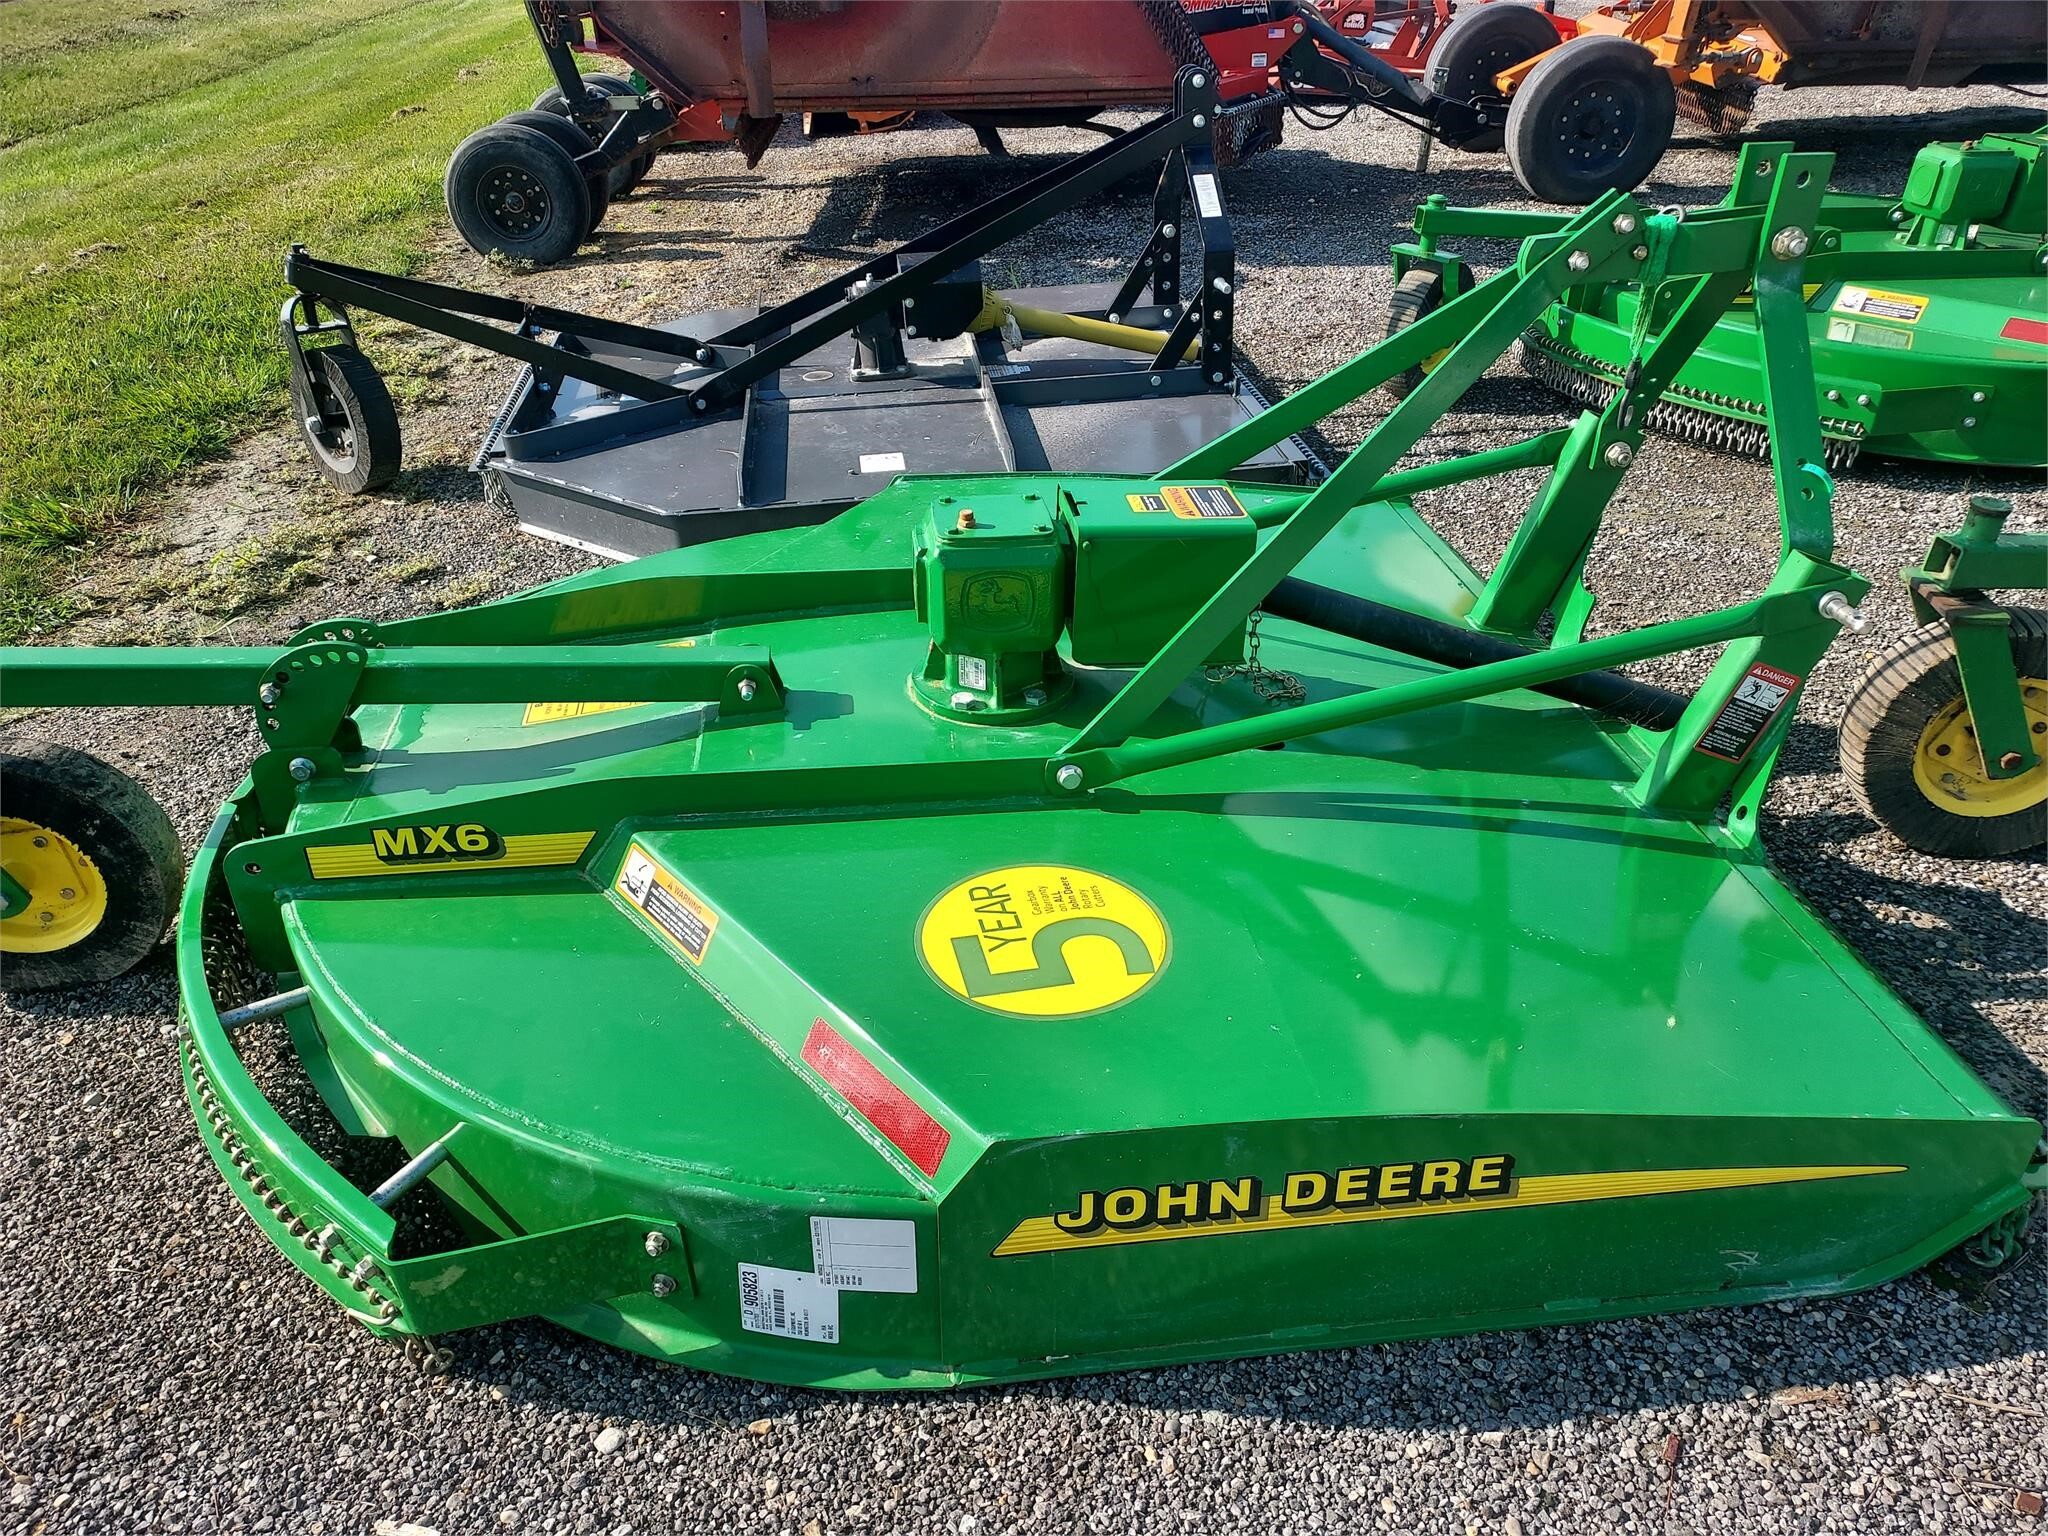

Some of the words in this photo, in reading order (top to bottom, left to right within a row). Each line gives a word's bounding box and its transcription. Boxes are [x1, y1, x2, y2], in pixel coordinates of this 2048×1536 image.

[1762, 669, 1796, 687] DANGER
[371, 823, 497, 860] MX6
[1051, 890, 1064, 902] ALL
[1060, 876, 1074, 895] Deere
[1090, 885, 1106, 908] Cutters
[674, 885, 703, 915] WARNING
[1027, 890, 1042, 916] Gearbox
[1038, 886, 1055, 914] Warranty
[1059, 903, 1068, 912] on
[1068, 895, 1081, 910] John
[1079, 889, 1093, 909] Rotary
[968, 883, 1027, 953] YEAR
[950, 916, 1156, 999] 5
[1055, 1177, 1257, 1233] JOHN
[1283, 1155, 1512, 1213] DEERE
[742, 1270, 759, 1307] 905823
